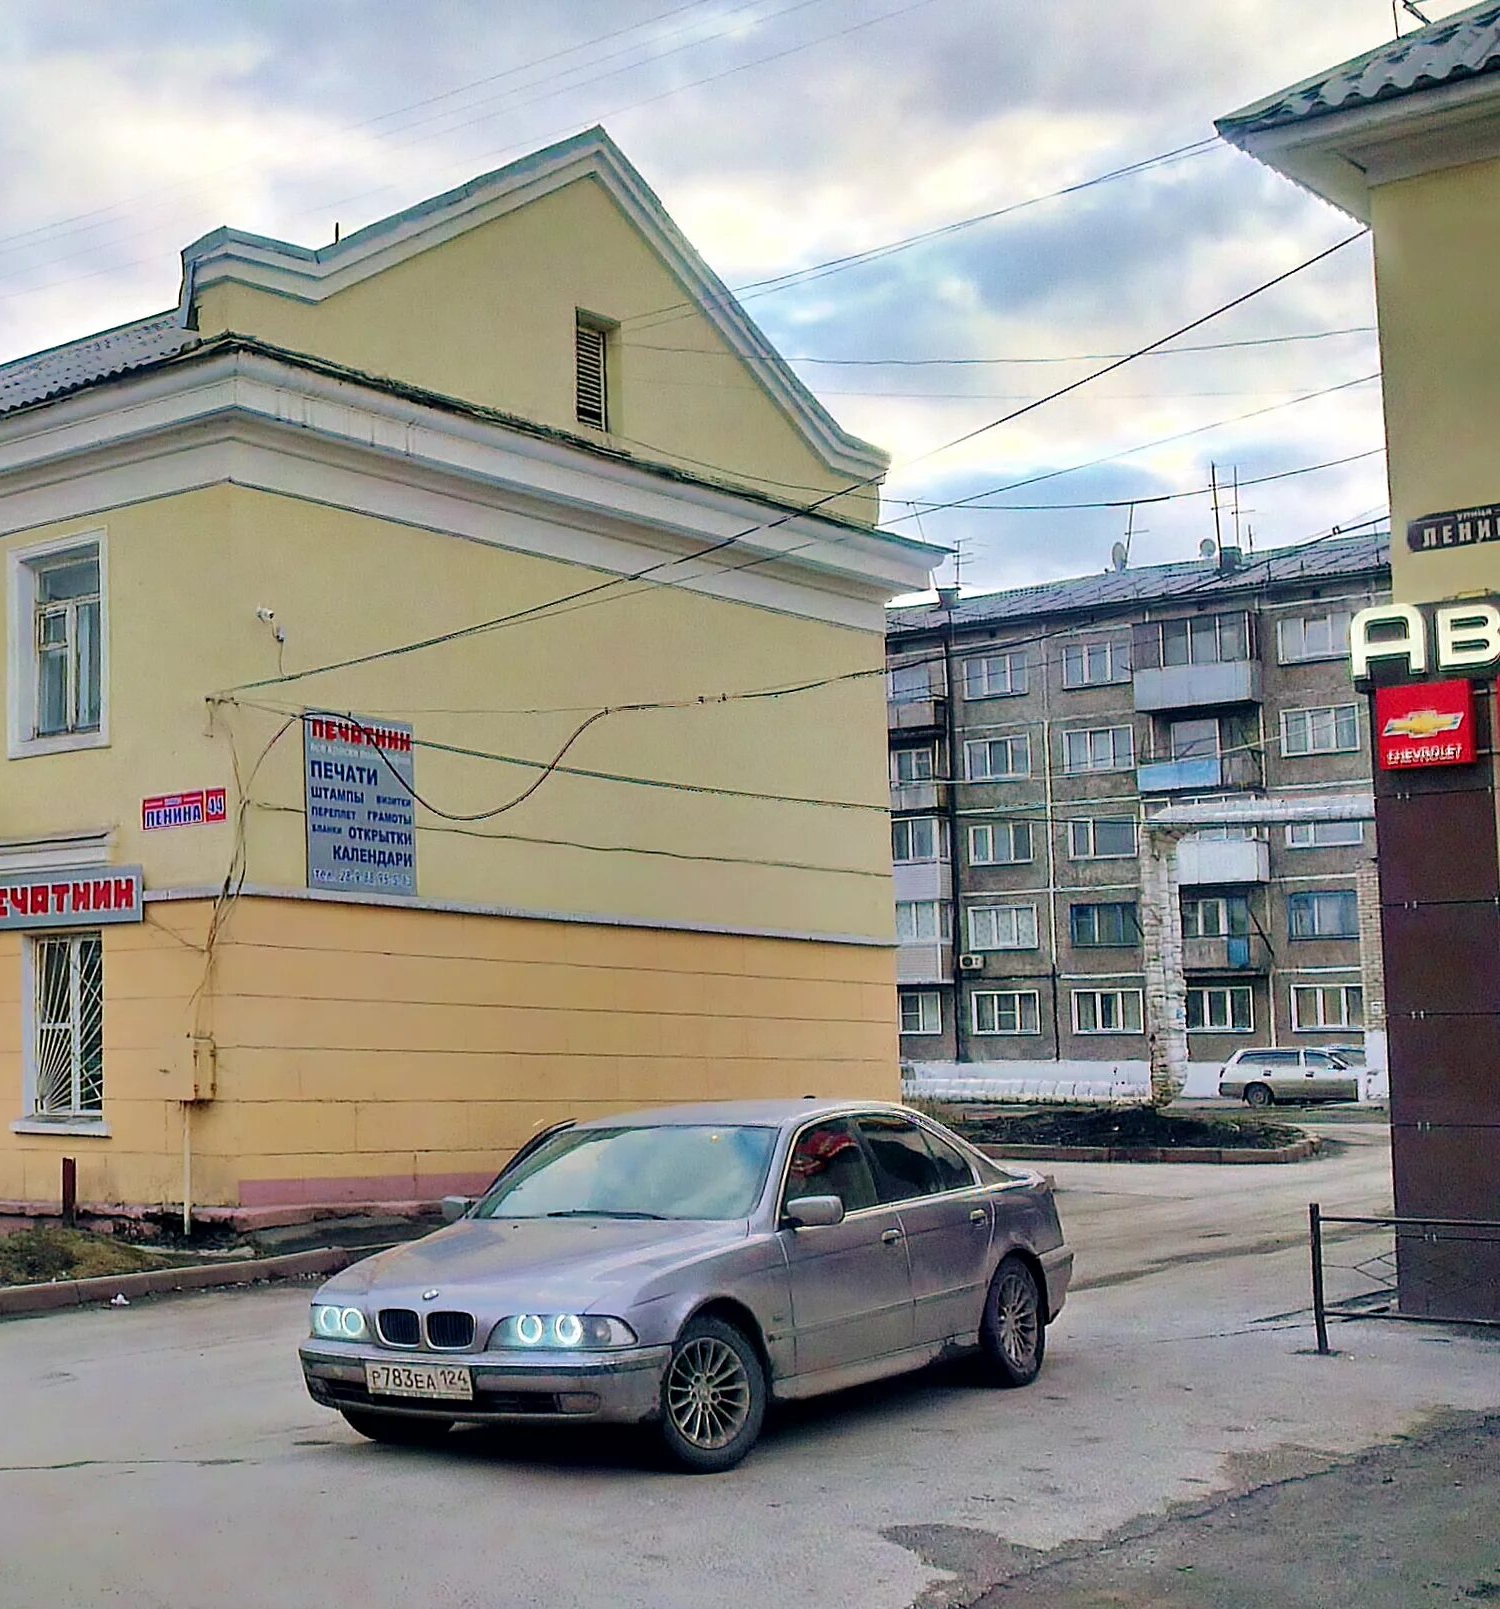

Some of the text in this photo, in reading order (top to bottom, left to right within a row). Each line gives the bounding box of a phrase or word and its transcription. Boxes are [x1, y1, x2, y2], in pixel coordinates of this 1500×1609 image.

[1387, 743, 1462, 765] CHEVROLET
[310, 760, 378, 786] ПЕЧАТИ
[311, 786, 364, 804] ШТАМПЫ
[146, 804, 201, 827] ЛЕНИНА
[311, 806, 412, 825] ПЕРЕПЛЕТ ГРАМОТЫ
[348, 826, 412, 845] ОТКРЫТКИ
[333, 845, 412, 868] КАЛЕНДАРИ
[372, 1367, 468, 1390] Р783ЕА 124
